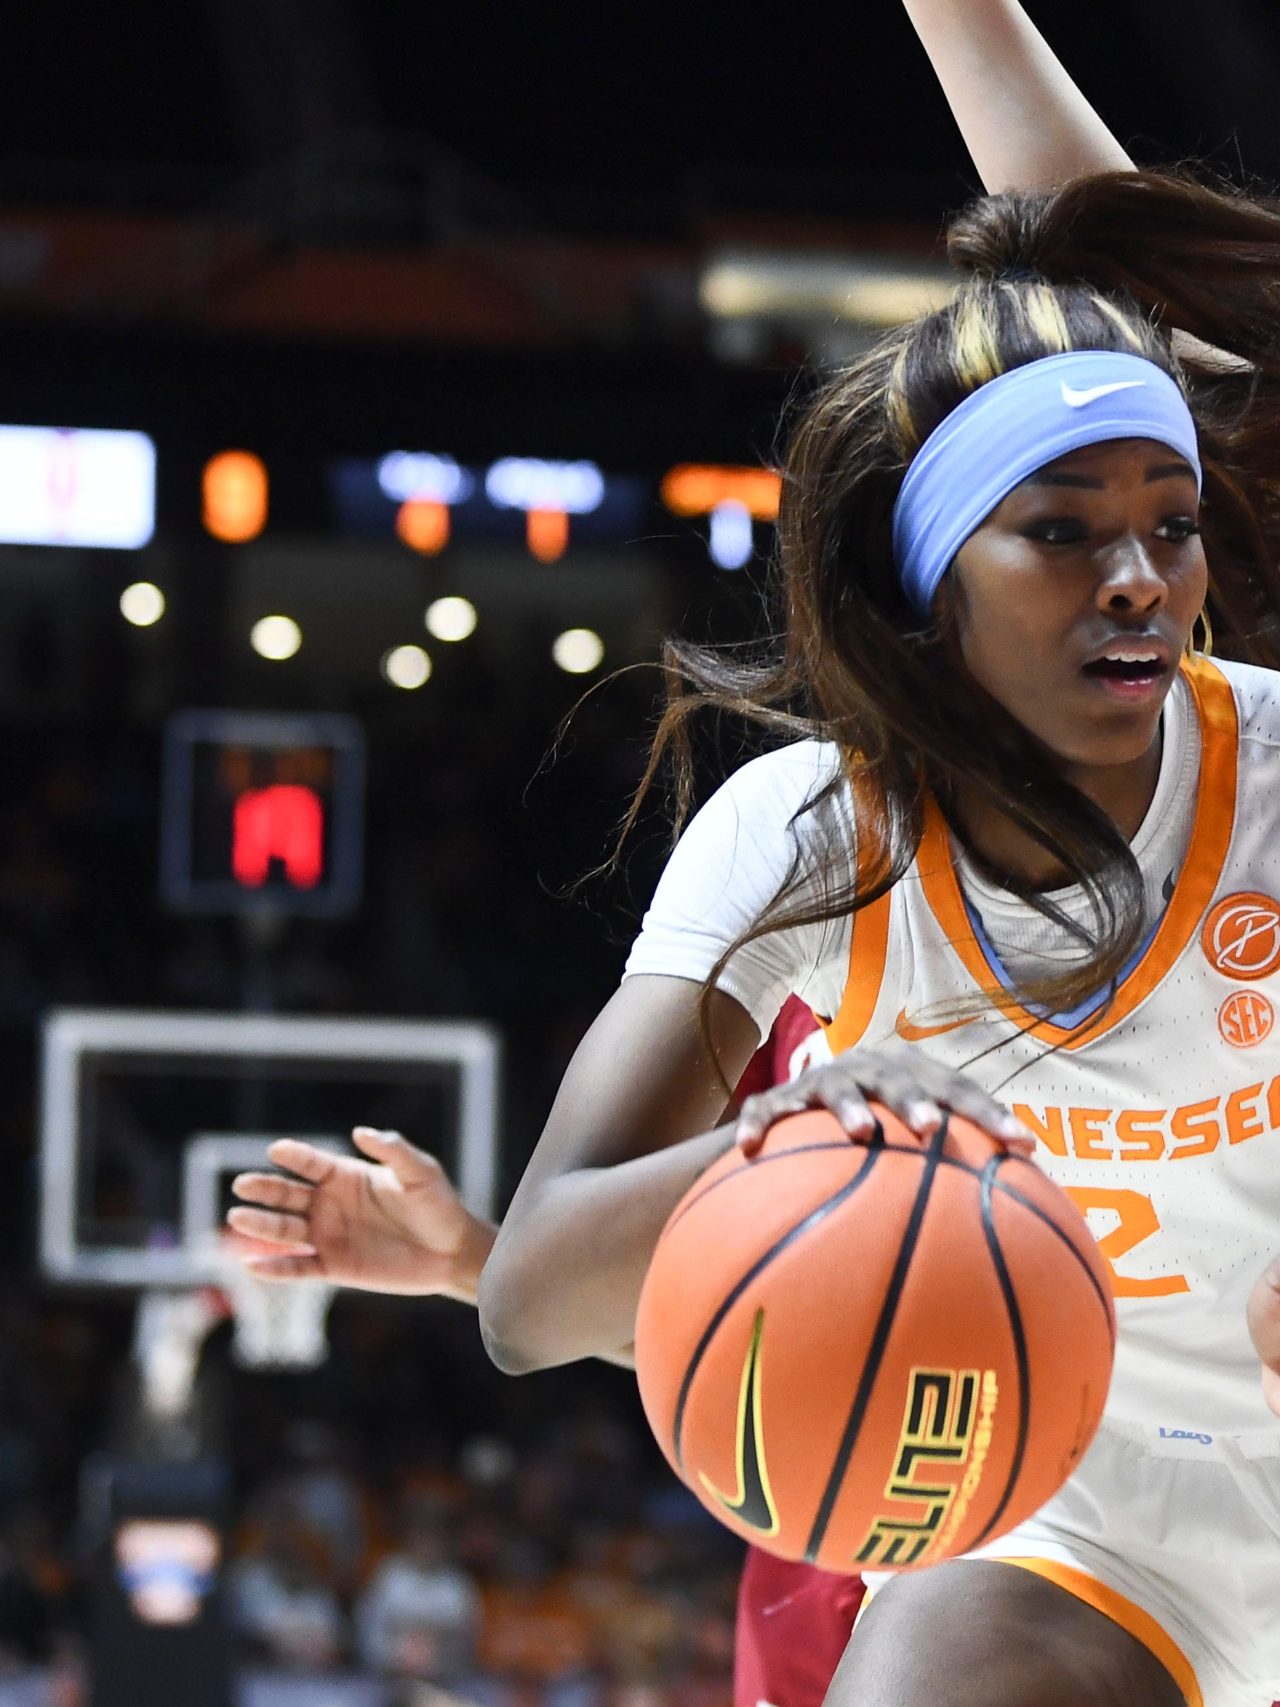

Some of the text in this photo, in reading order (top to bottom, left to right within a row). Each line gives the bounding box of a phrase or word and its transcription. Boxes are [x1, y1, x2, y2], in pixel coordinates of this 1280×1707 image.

[1222, 994, 1270, 1044] SEC
[1061, 1185, 1191, 1298] 2
[854, 1366, 981, 1567] ELITE
